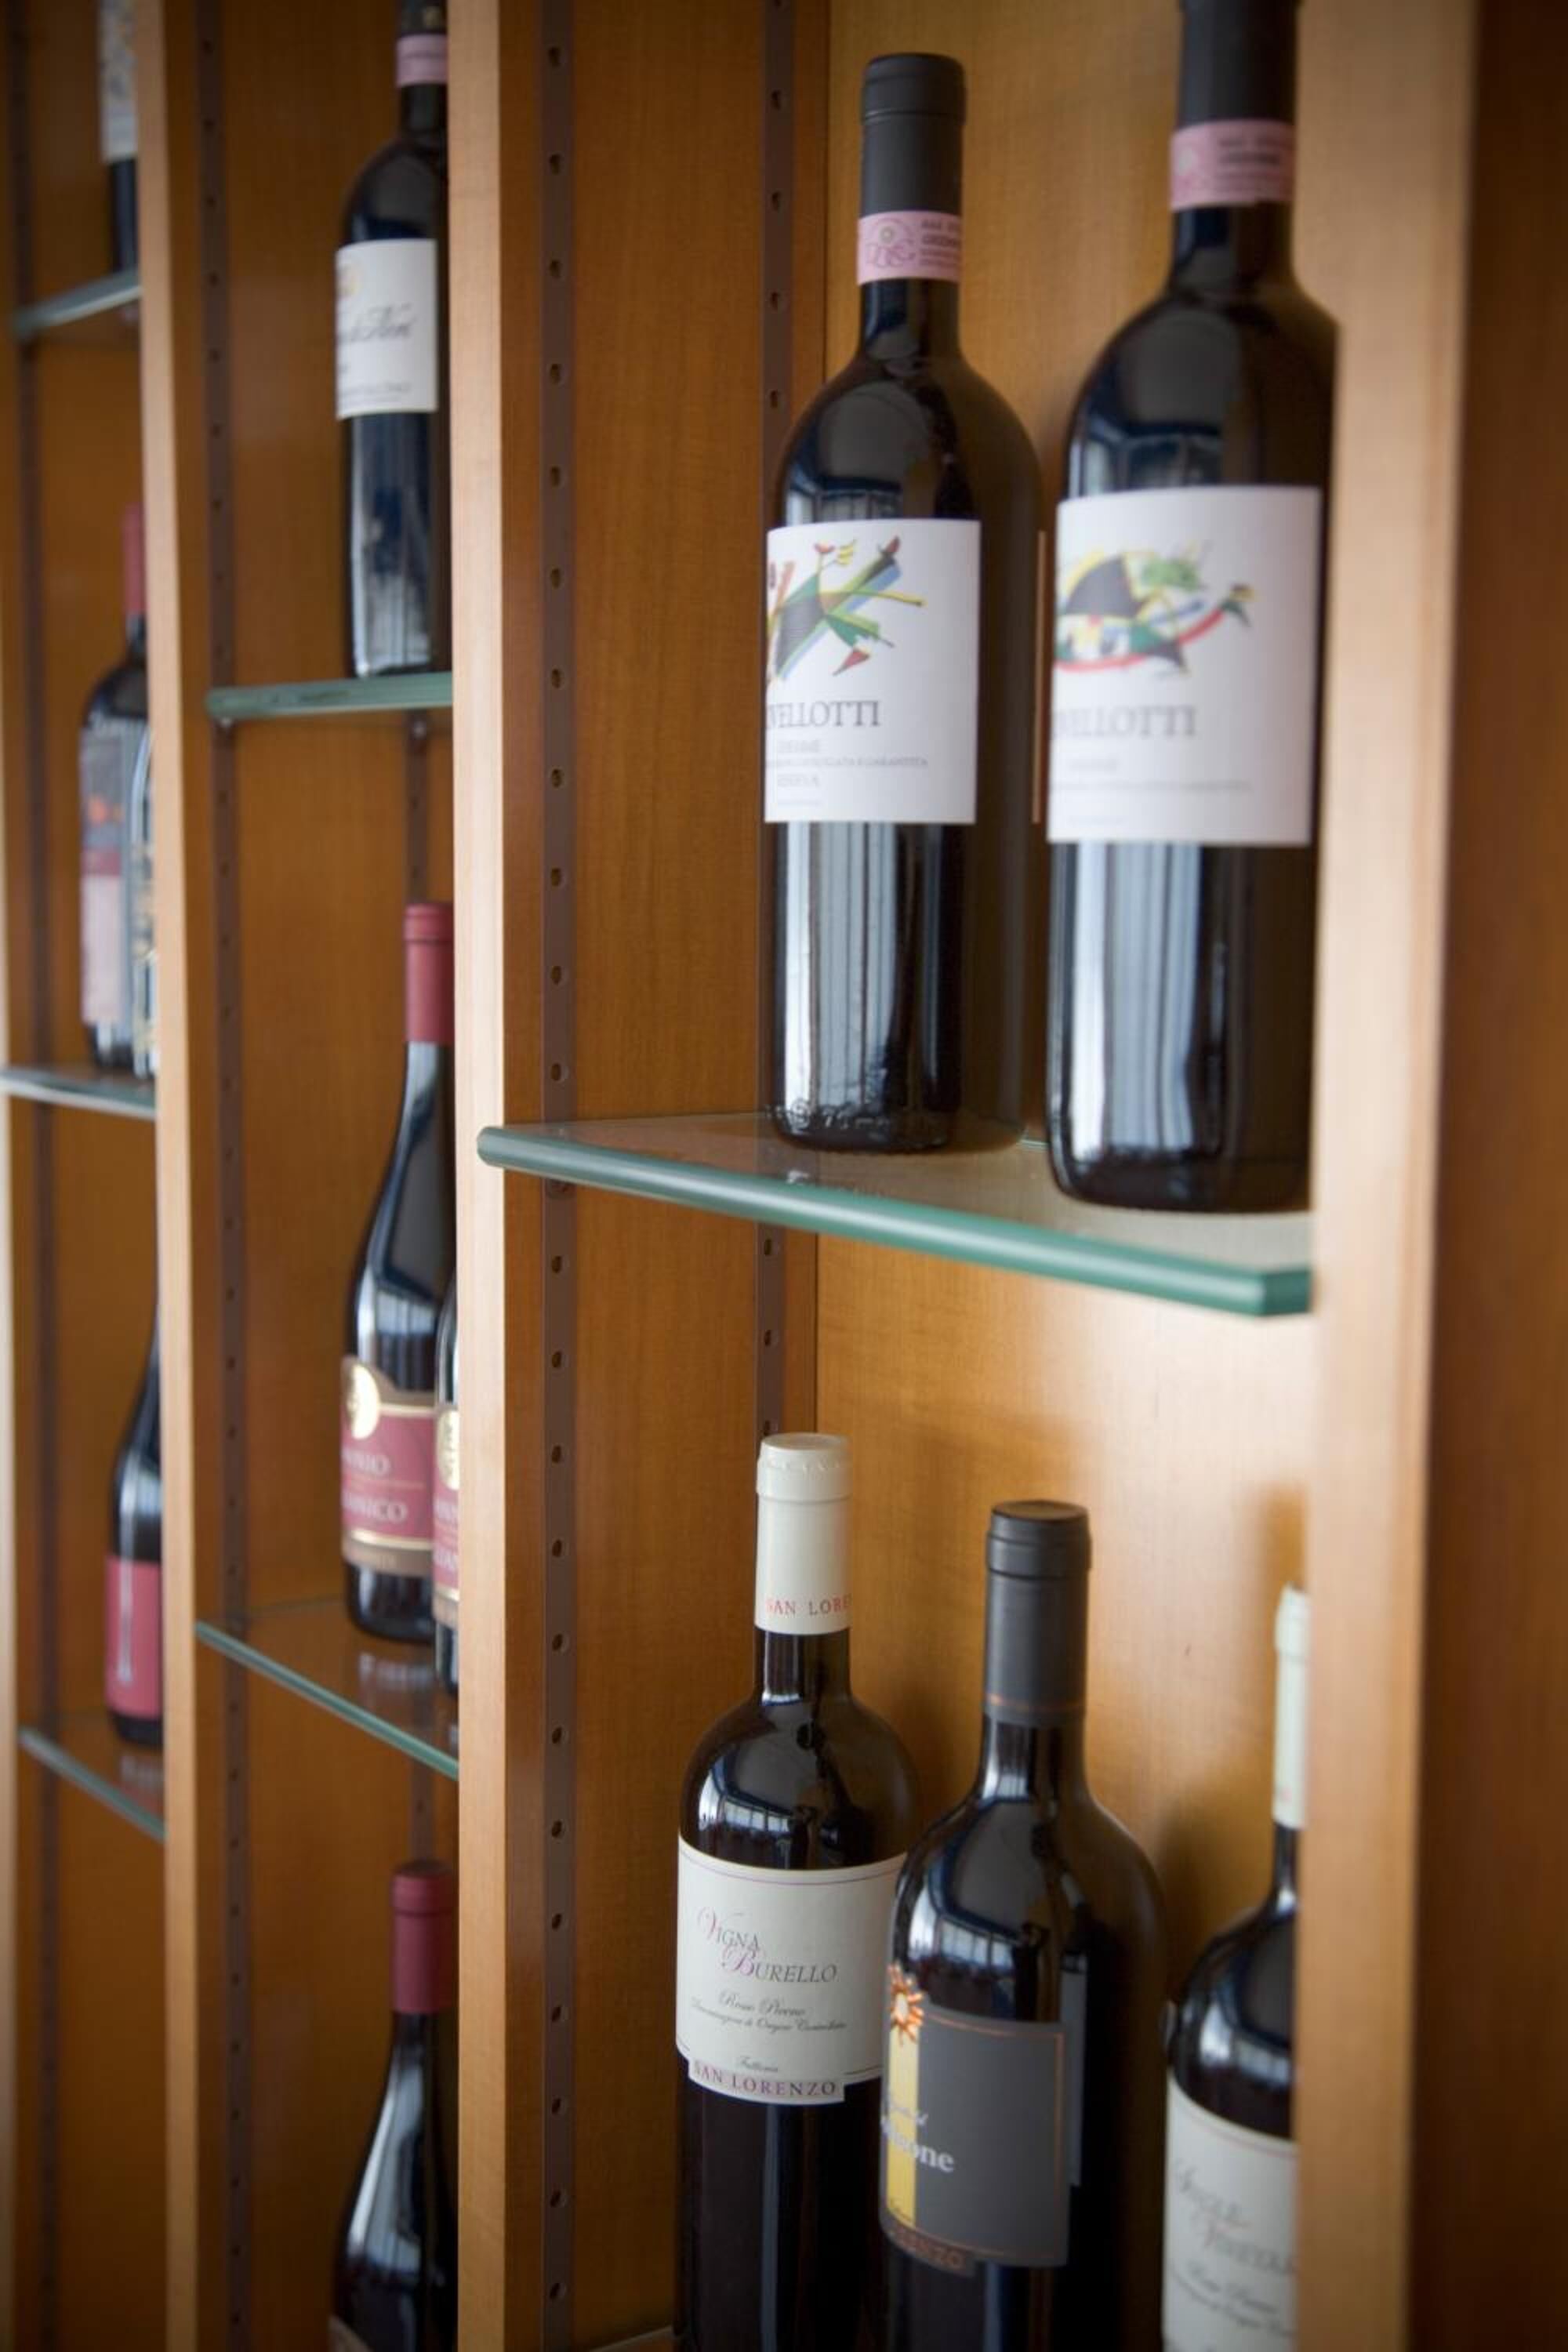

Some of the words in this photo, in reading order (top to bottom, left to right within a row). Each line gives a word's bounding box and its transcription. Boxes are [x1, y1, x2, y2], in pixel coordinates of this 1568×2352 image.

[720, 1946, 839, 1984] BURELLO
[693, 2060, 722, 2083] SAN
[731, 2074, 837, 2096] LORENZO
